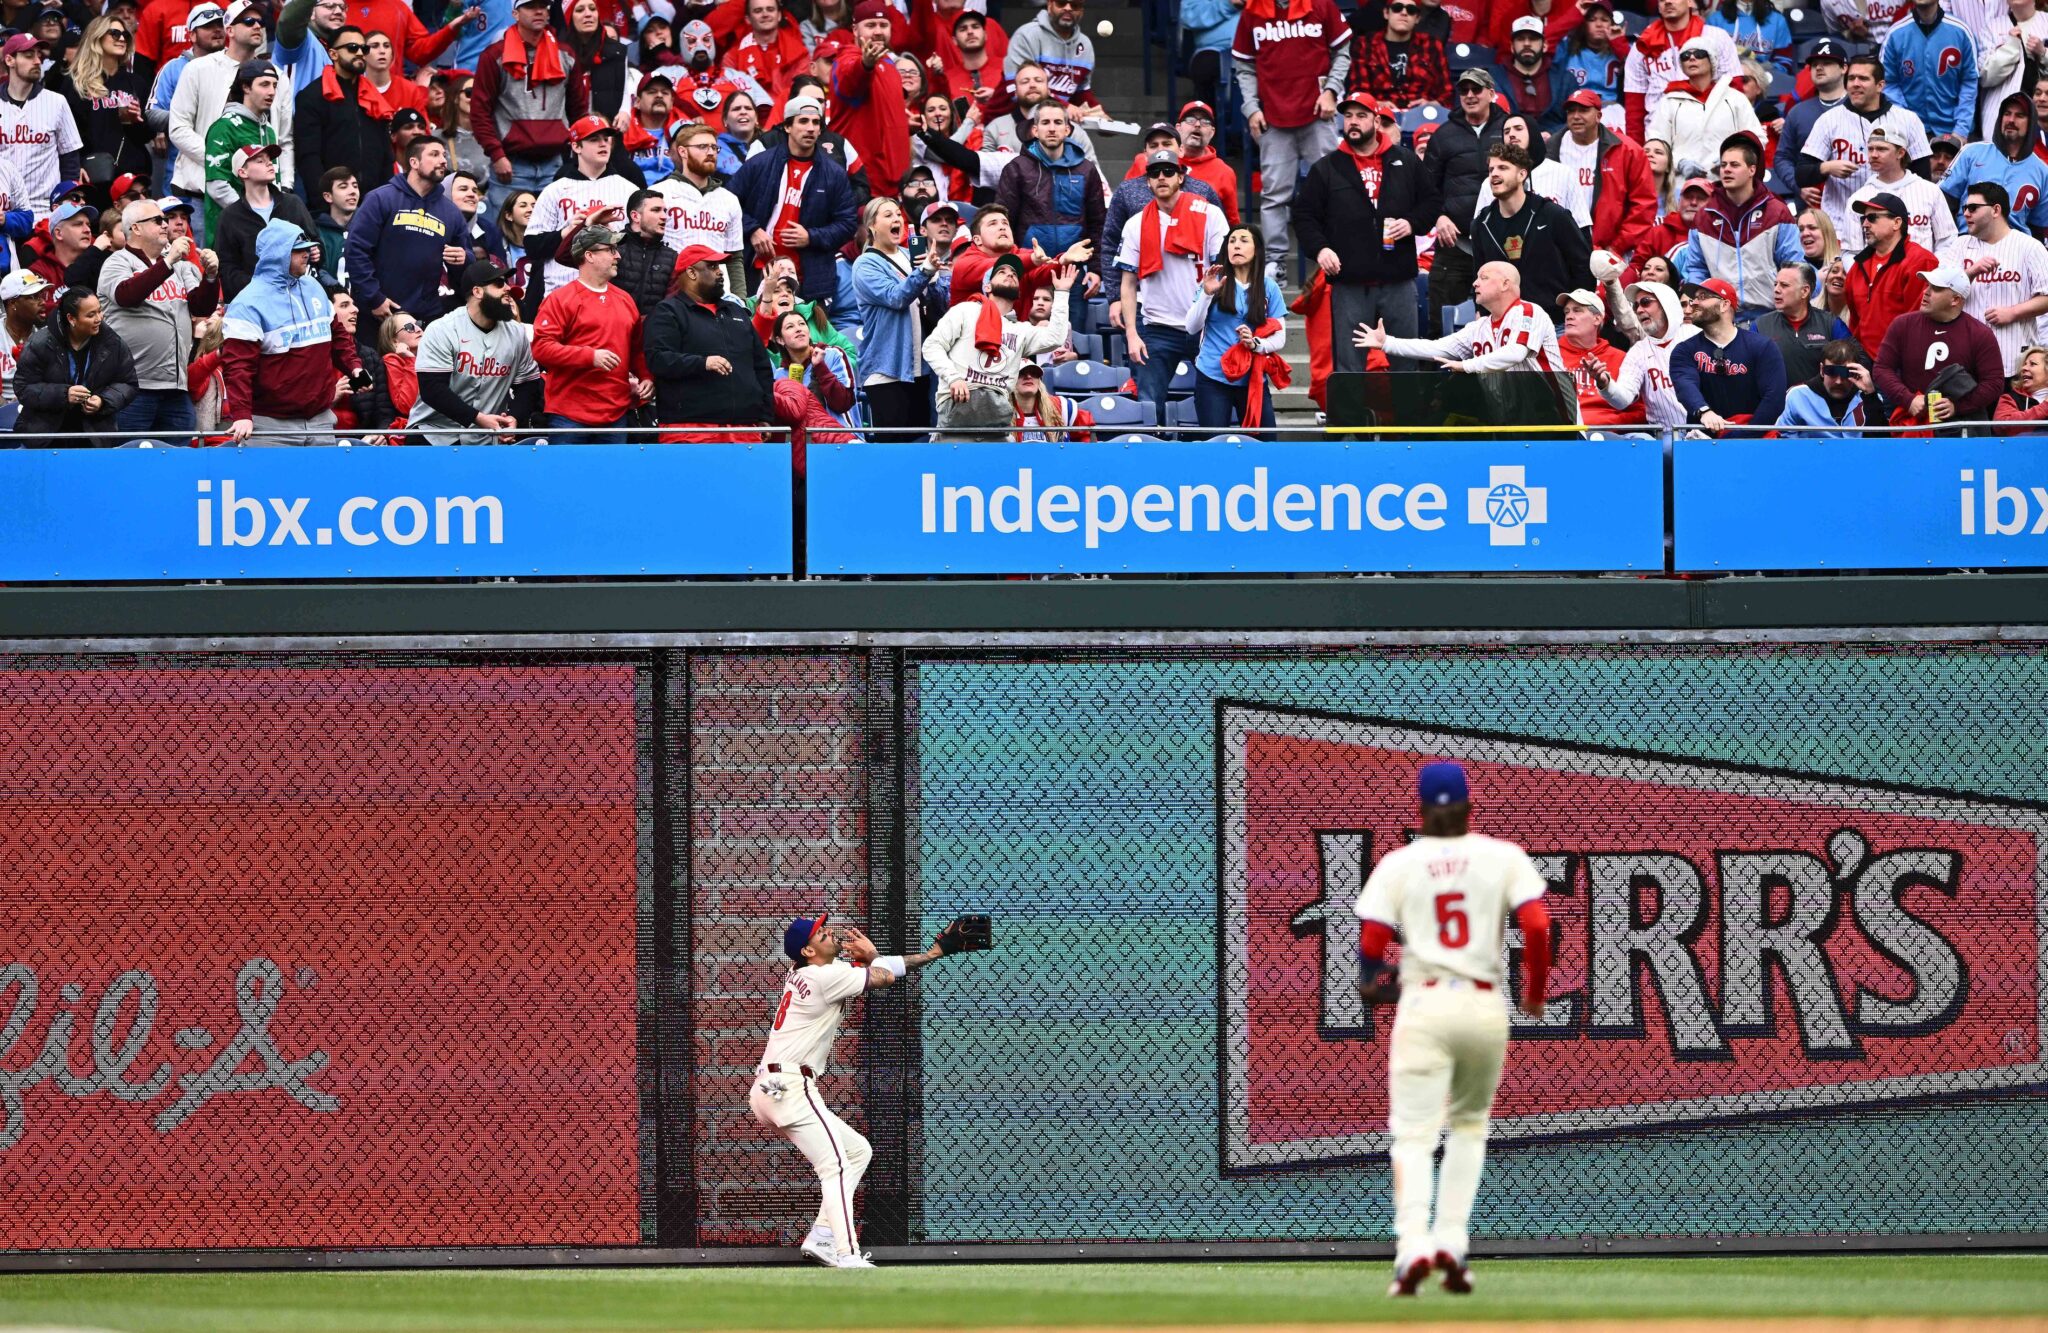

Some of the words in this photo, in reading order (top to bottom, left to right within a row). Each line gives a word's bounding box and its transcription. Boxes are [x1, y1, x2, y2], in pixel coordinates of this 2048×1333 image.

[1903, 60, 1915, 77] 3
[1937, 47, 1962, 78] P
[2012, 184, 2040, 213] P
[1924, 341, 1950, 370] P
[196, 479, 505, 547] ibx.com
[921, 466, 1448, 549] Independence
[1433, 891, 1470, 949] 5
[773, 990, 792, 1031] 8
